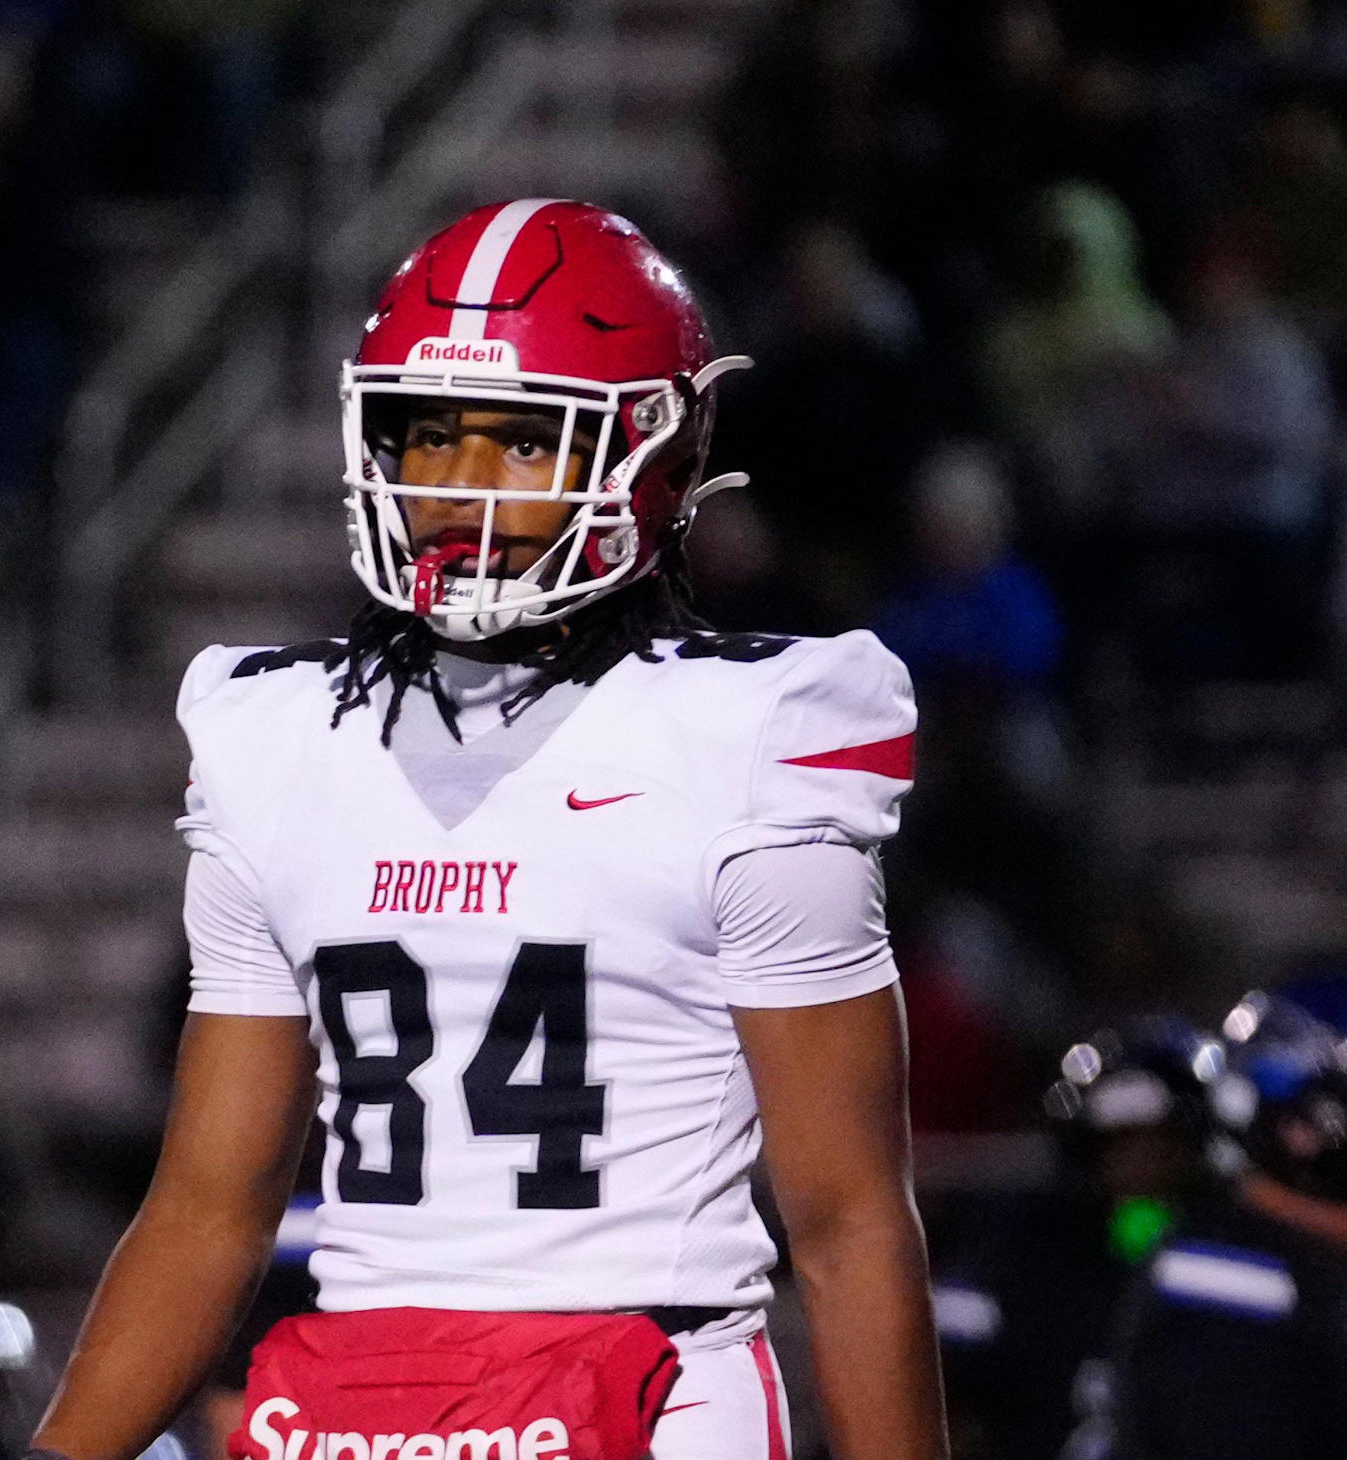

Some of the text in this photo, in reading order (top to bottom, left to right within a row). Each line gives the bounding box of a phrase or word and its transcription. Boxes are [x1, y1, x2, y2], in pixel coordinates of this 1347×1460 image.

[420, 343, 503, 362] Riddell
[368, 860, 518, 914] BROPHY
[311, 935, 607, 1211] 84
